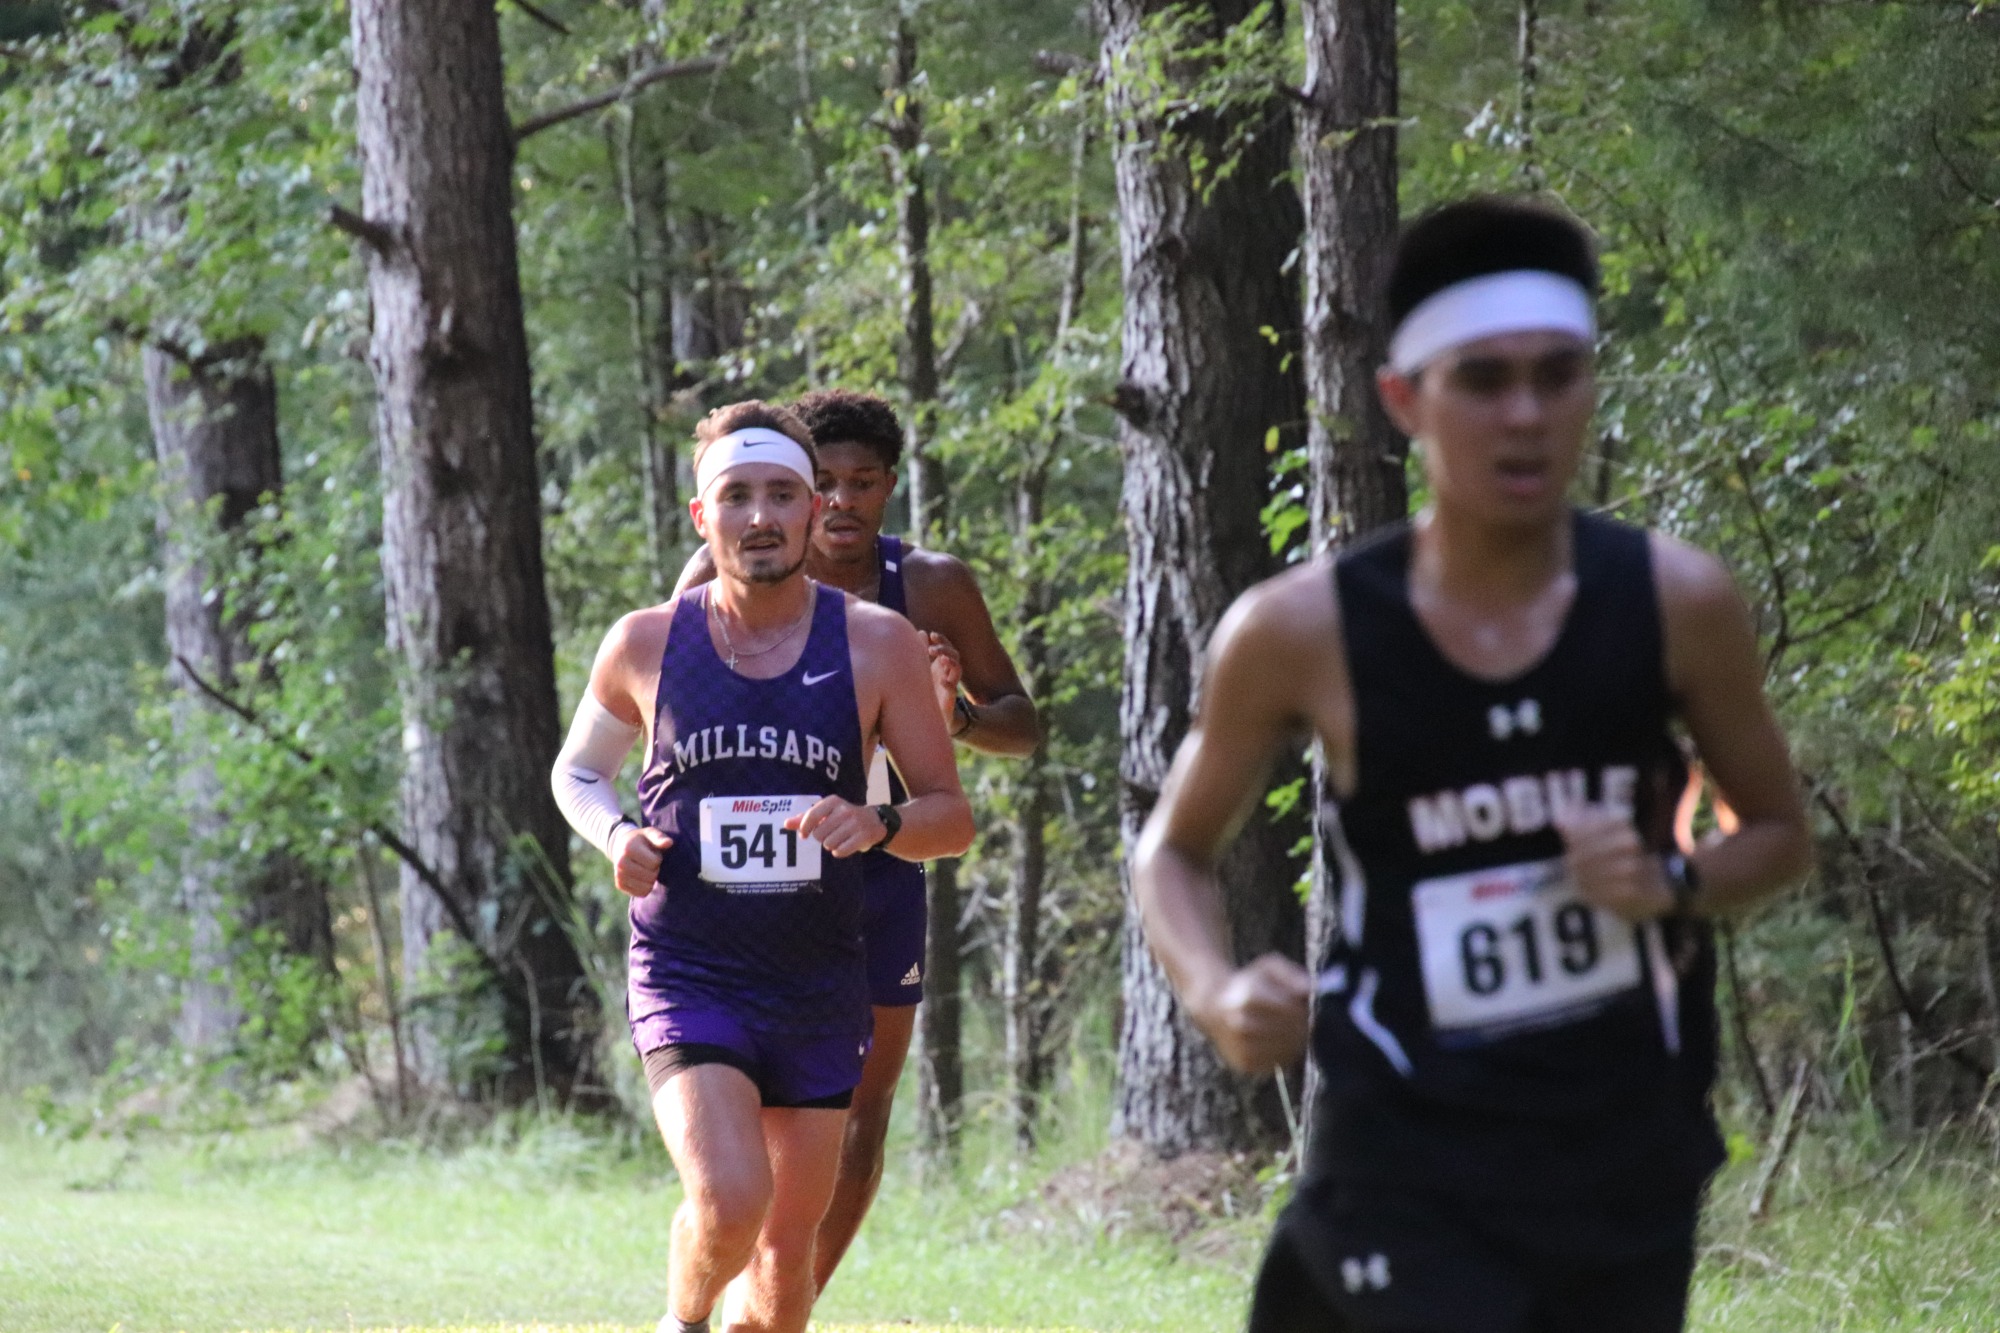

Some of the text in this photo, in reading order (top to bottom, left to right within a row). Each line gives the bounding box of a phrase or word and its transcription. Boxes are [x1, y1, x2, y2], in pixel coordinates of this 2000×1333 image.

[673, 724, 842, 780] MILLSAPS
[720, 823, 797, 869] 541
[1460, 903, 1599, 997] 619
